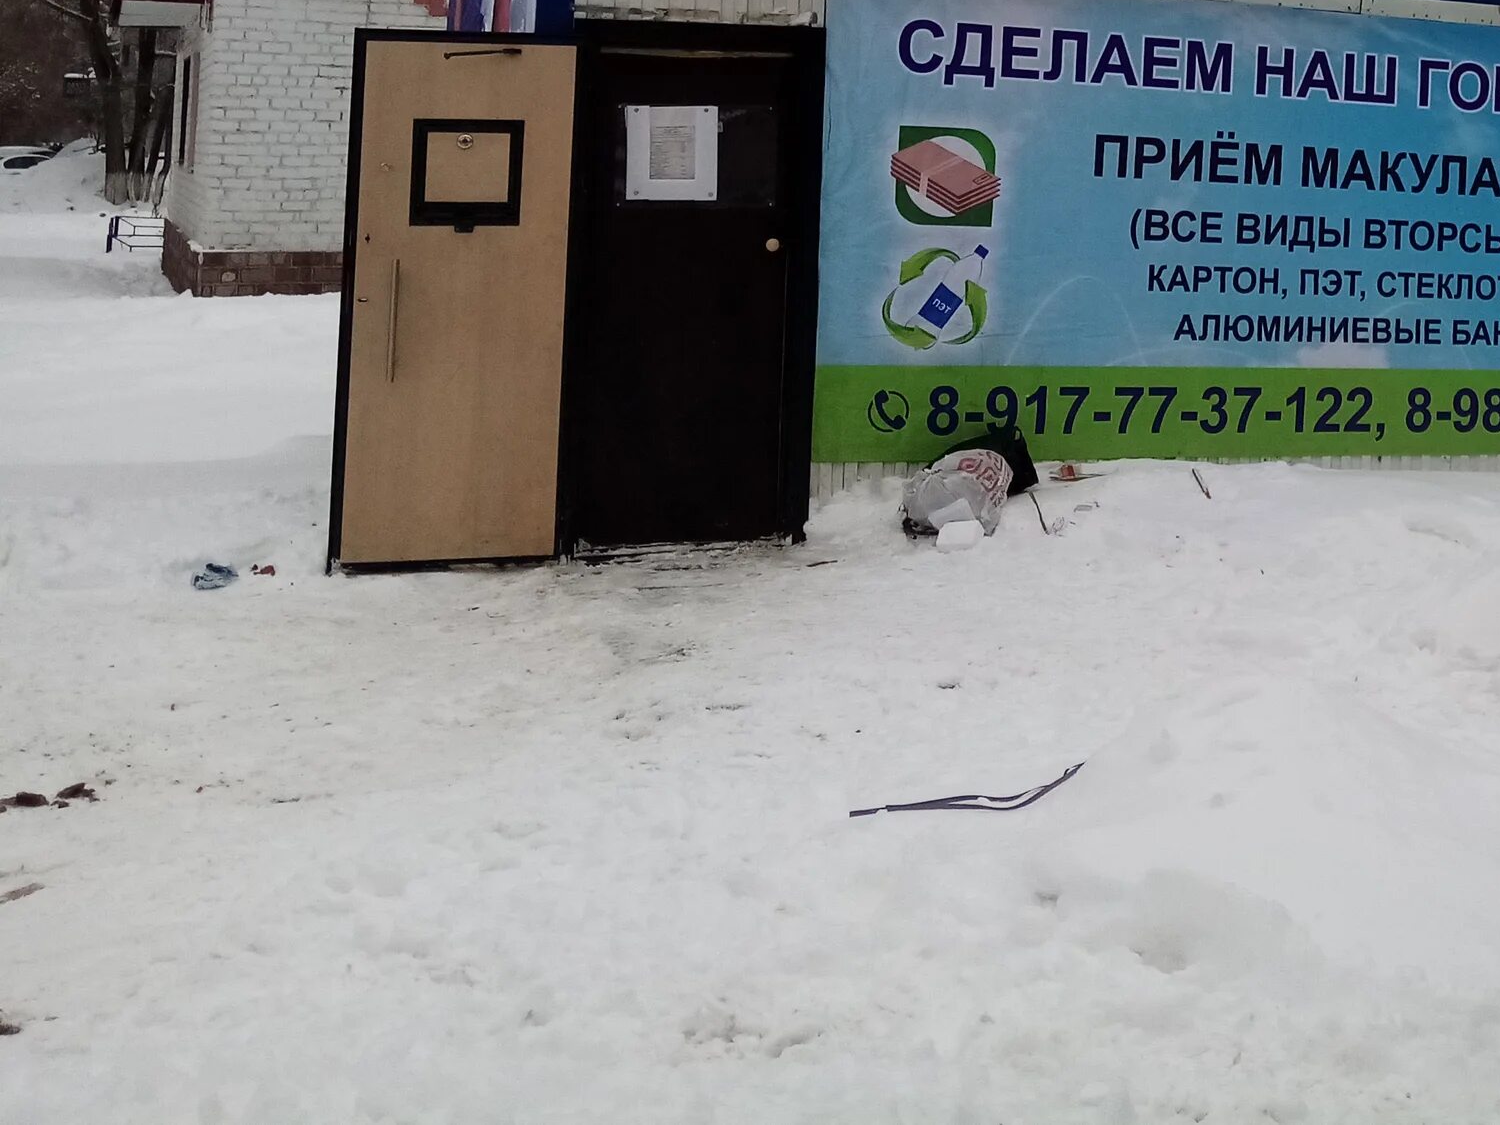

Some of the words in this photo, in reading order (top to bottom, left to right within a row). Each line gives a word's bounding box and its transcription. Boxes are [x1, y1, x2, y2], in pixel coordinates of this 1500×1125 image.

[898, 19, 1232, 93] СДЕЛАЕМ
[1255, 45, 1397, 105] НАШ
[1093, 131, 1283, 187] ПРИЁМ
[1130, 208, 1222, 249] (ВСЕ
[1236, 214, 1350, 252] ВИДЫ
[1147, 264, 1287, 299] КАРТОН,
[1299, 269, 1366, 301] ПЭТ,
[932, 297, 952, 314] ПЭТ
[1173, 314, 1442, 346] АЛЮМИНИЕВЫЕ
[926, 384, 1386, 442] 8-917-77-37-122,
